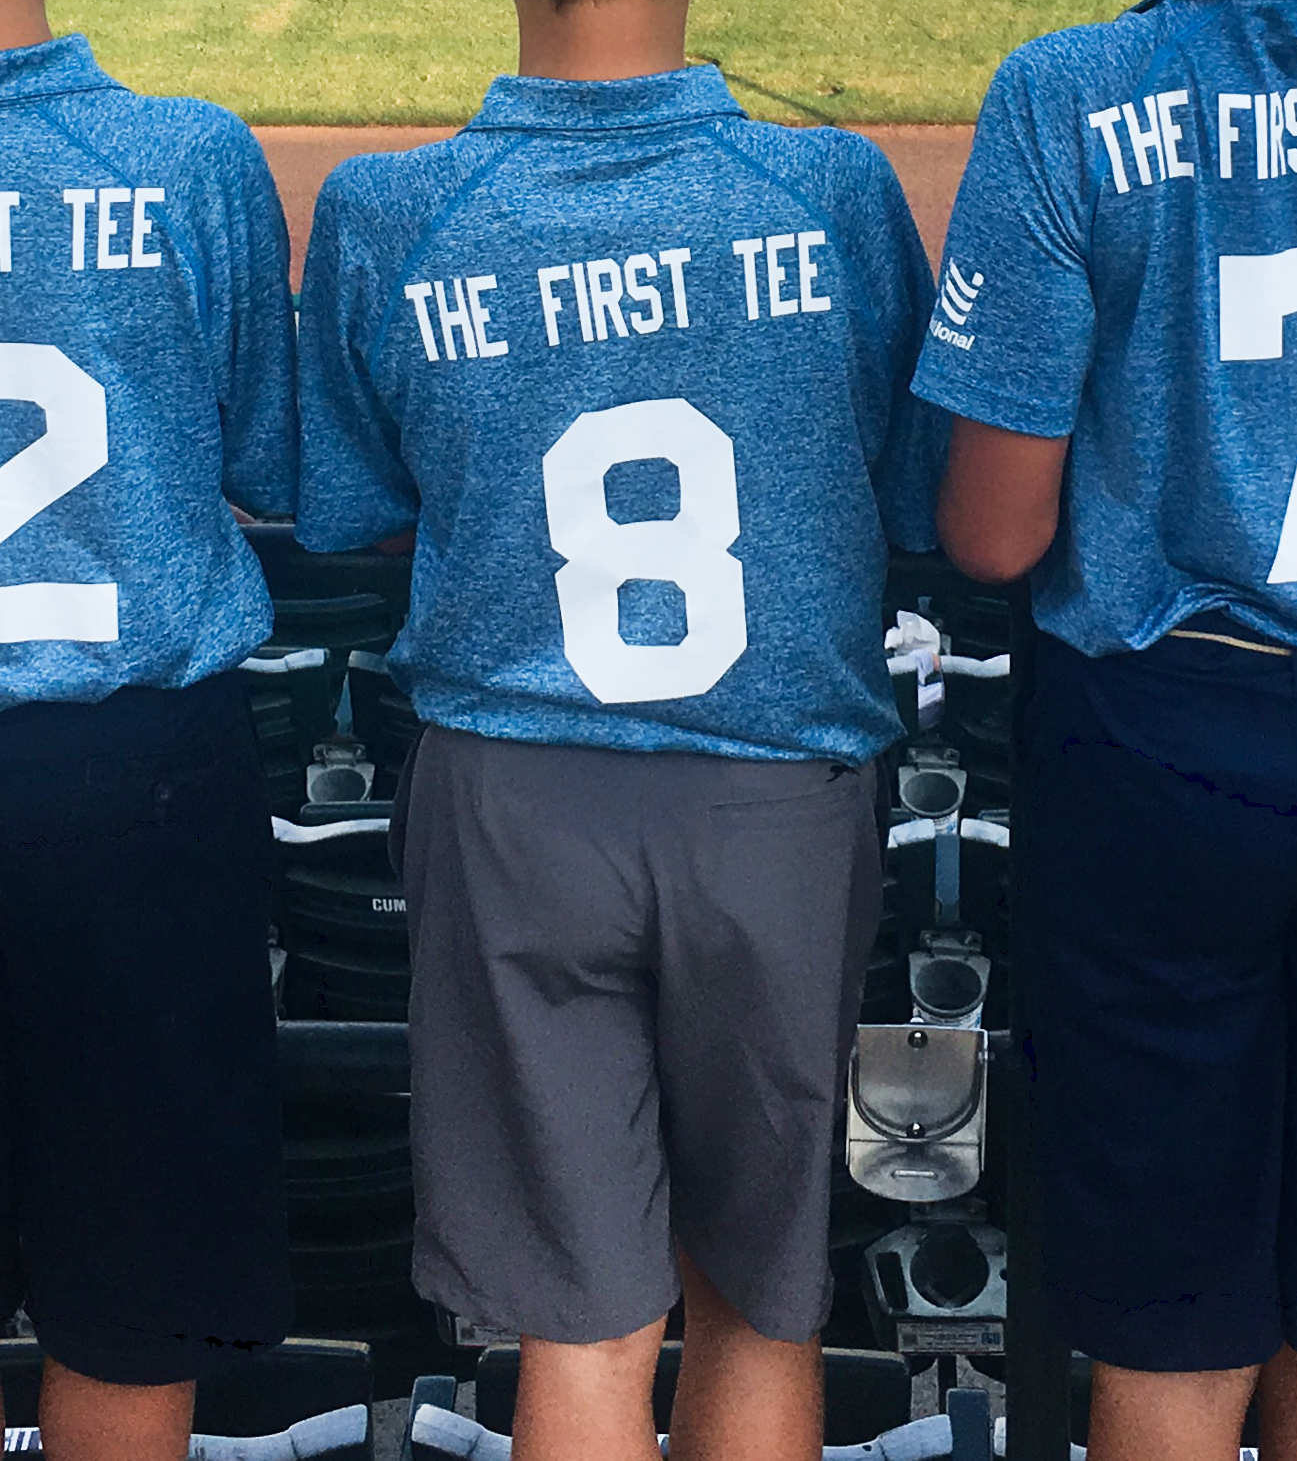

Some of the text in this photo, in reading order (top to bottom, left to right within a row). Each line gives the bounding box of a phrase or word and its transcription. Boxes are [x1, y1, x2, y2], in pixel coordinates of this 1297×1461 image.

[1087, 88, 1195, 194] THE
[62, 186, 166, 271] TEE
[404, 229, 832, 363] THE FIRST TEE
[541, 397, 749, 705] 8
